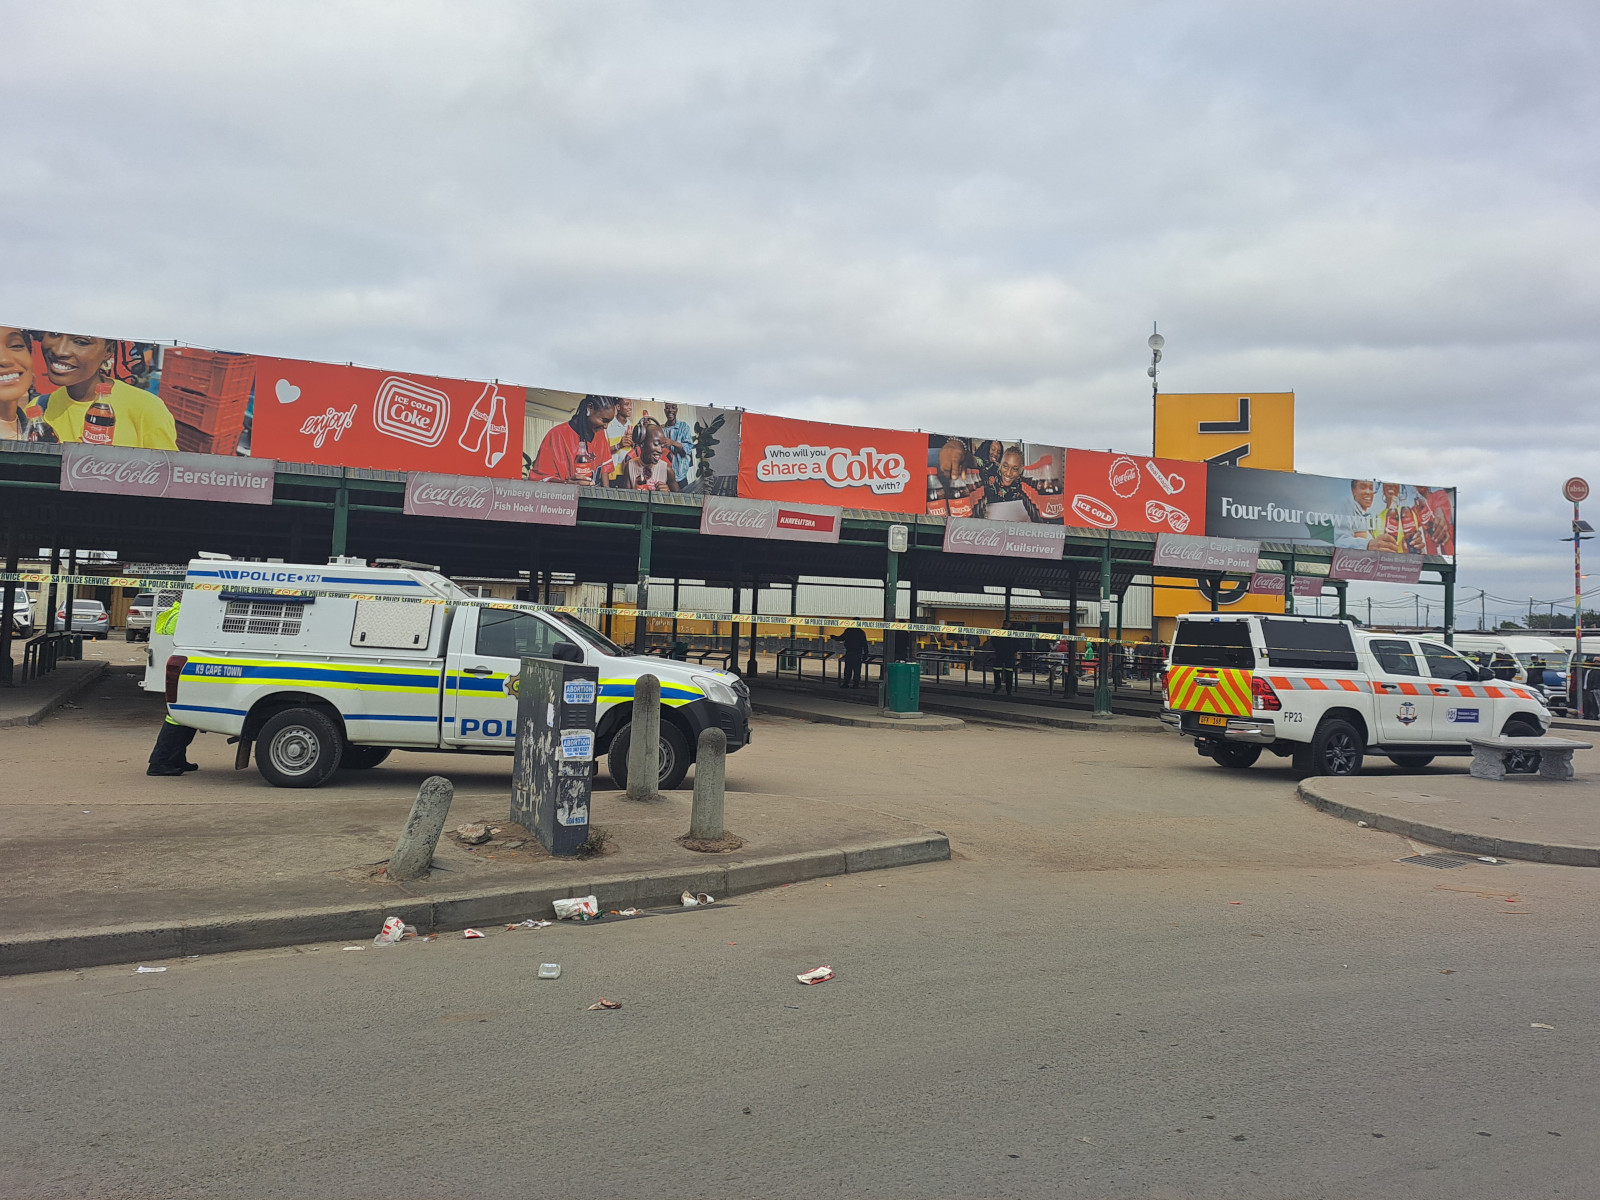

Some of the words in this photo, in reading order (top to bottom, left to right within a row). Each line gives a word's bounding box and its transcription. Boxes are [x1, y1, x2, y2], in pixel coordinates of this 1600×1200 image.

[394, 394, 409, 404] ICE
[410, 398, 434, 413] COLD
[390, 403, 430, 430] Coke
[300, 404, 358, 448] enjoy!
[769, 448, 790, 458] Who
[792, 448, 806, 458] will
[808, 449, 826, 460] you
[762, 460, 808, 478] share
[811, 463, 823, 475] a
[825, 452, 901, 482] Coke
[173, 467, 268, 490] Eersterivier
[876, 480, 901, 492] with?
[534, 489, 575, 501] Claremont
[494, 501, 512, 512] Fish
[514, 502, 534, 512] Hoek
[541, 505, 576, 518] Mowbray
[1077, 500, 1090, 512] ICE
[1091, 508, 1112, 522] COLD
[1222, 497, 1303, 524] Four-four
[1306, 510, 1342, 527] crew
[1346, 513, 1384, 532] with
[1008, 526, 1066, 540] Blackheath
[1006, 542, 1055, 554] Kuilsriver
[1210, 542, 1232, 552] Cape
[1236, 543, 1259, 554] Town
[1208, 556, 1225, 566] Sea
[1227, 558, 1250, 568] Point
[51, 575, 60, 583] SA
[61, 576, 83, 584] POLICE
[84, 577, 110, 585] SERVICE
[240, 571, 297, 583] POLICE
[306, 574, 321, 583] XZ7
[138, 579, 148, 587] SA
[149, 580, 168, 589] POLICE
[170, 581, 194, 590] SERVICE
[231, 586, 250, 594] POLICE
[251, 587, 274, 595] SERVICE
[195, 664, 205, 674] K9
[206, 665, 222, 676] CAPE
[222, 666, 243, 677] TOWN
[566, 685, 593, 693] ABORTION
[1284, 712, 1303, 723] FP23
[564, 738, 590, 747] ABORTION
